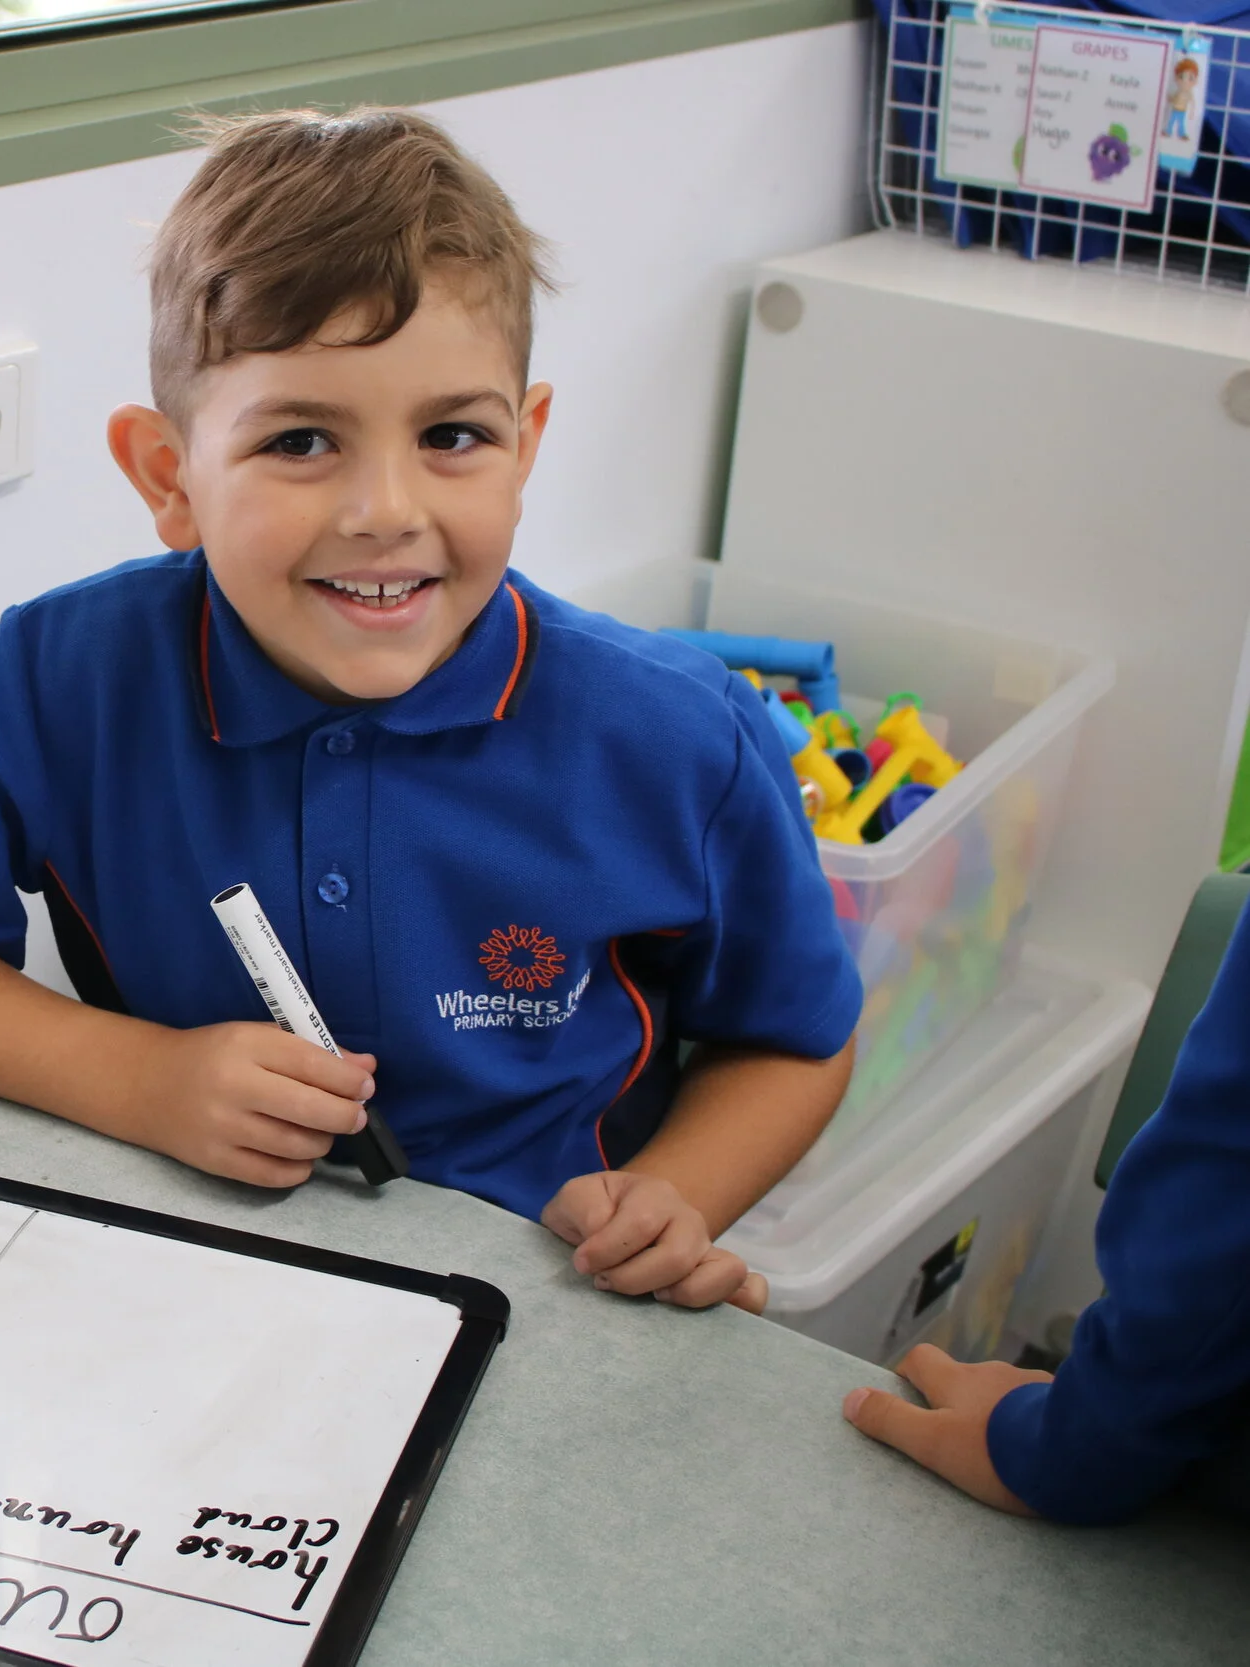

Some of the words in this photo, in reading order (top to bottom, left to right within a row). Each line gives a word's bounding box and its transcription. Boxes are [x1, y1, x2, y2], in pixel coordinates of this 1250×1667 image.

[1072, 41, 1129, 61] GRAPES
[1032, 121, 1070, 150] Hugo
[254, 913, 278, 949] marker
[274, 950, 309, 1008] whiteboard
[436, 990, 559, 1018] Wheelers
[454, 1013, 516, 1031] PRIMARY
[176, 1535, 329, 1611] house
